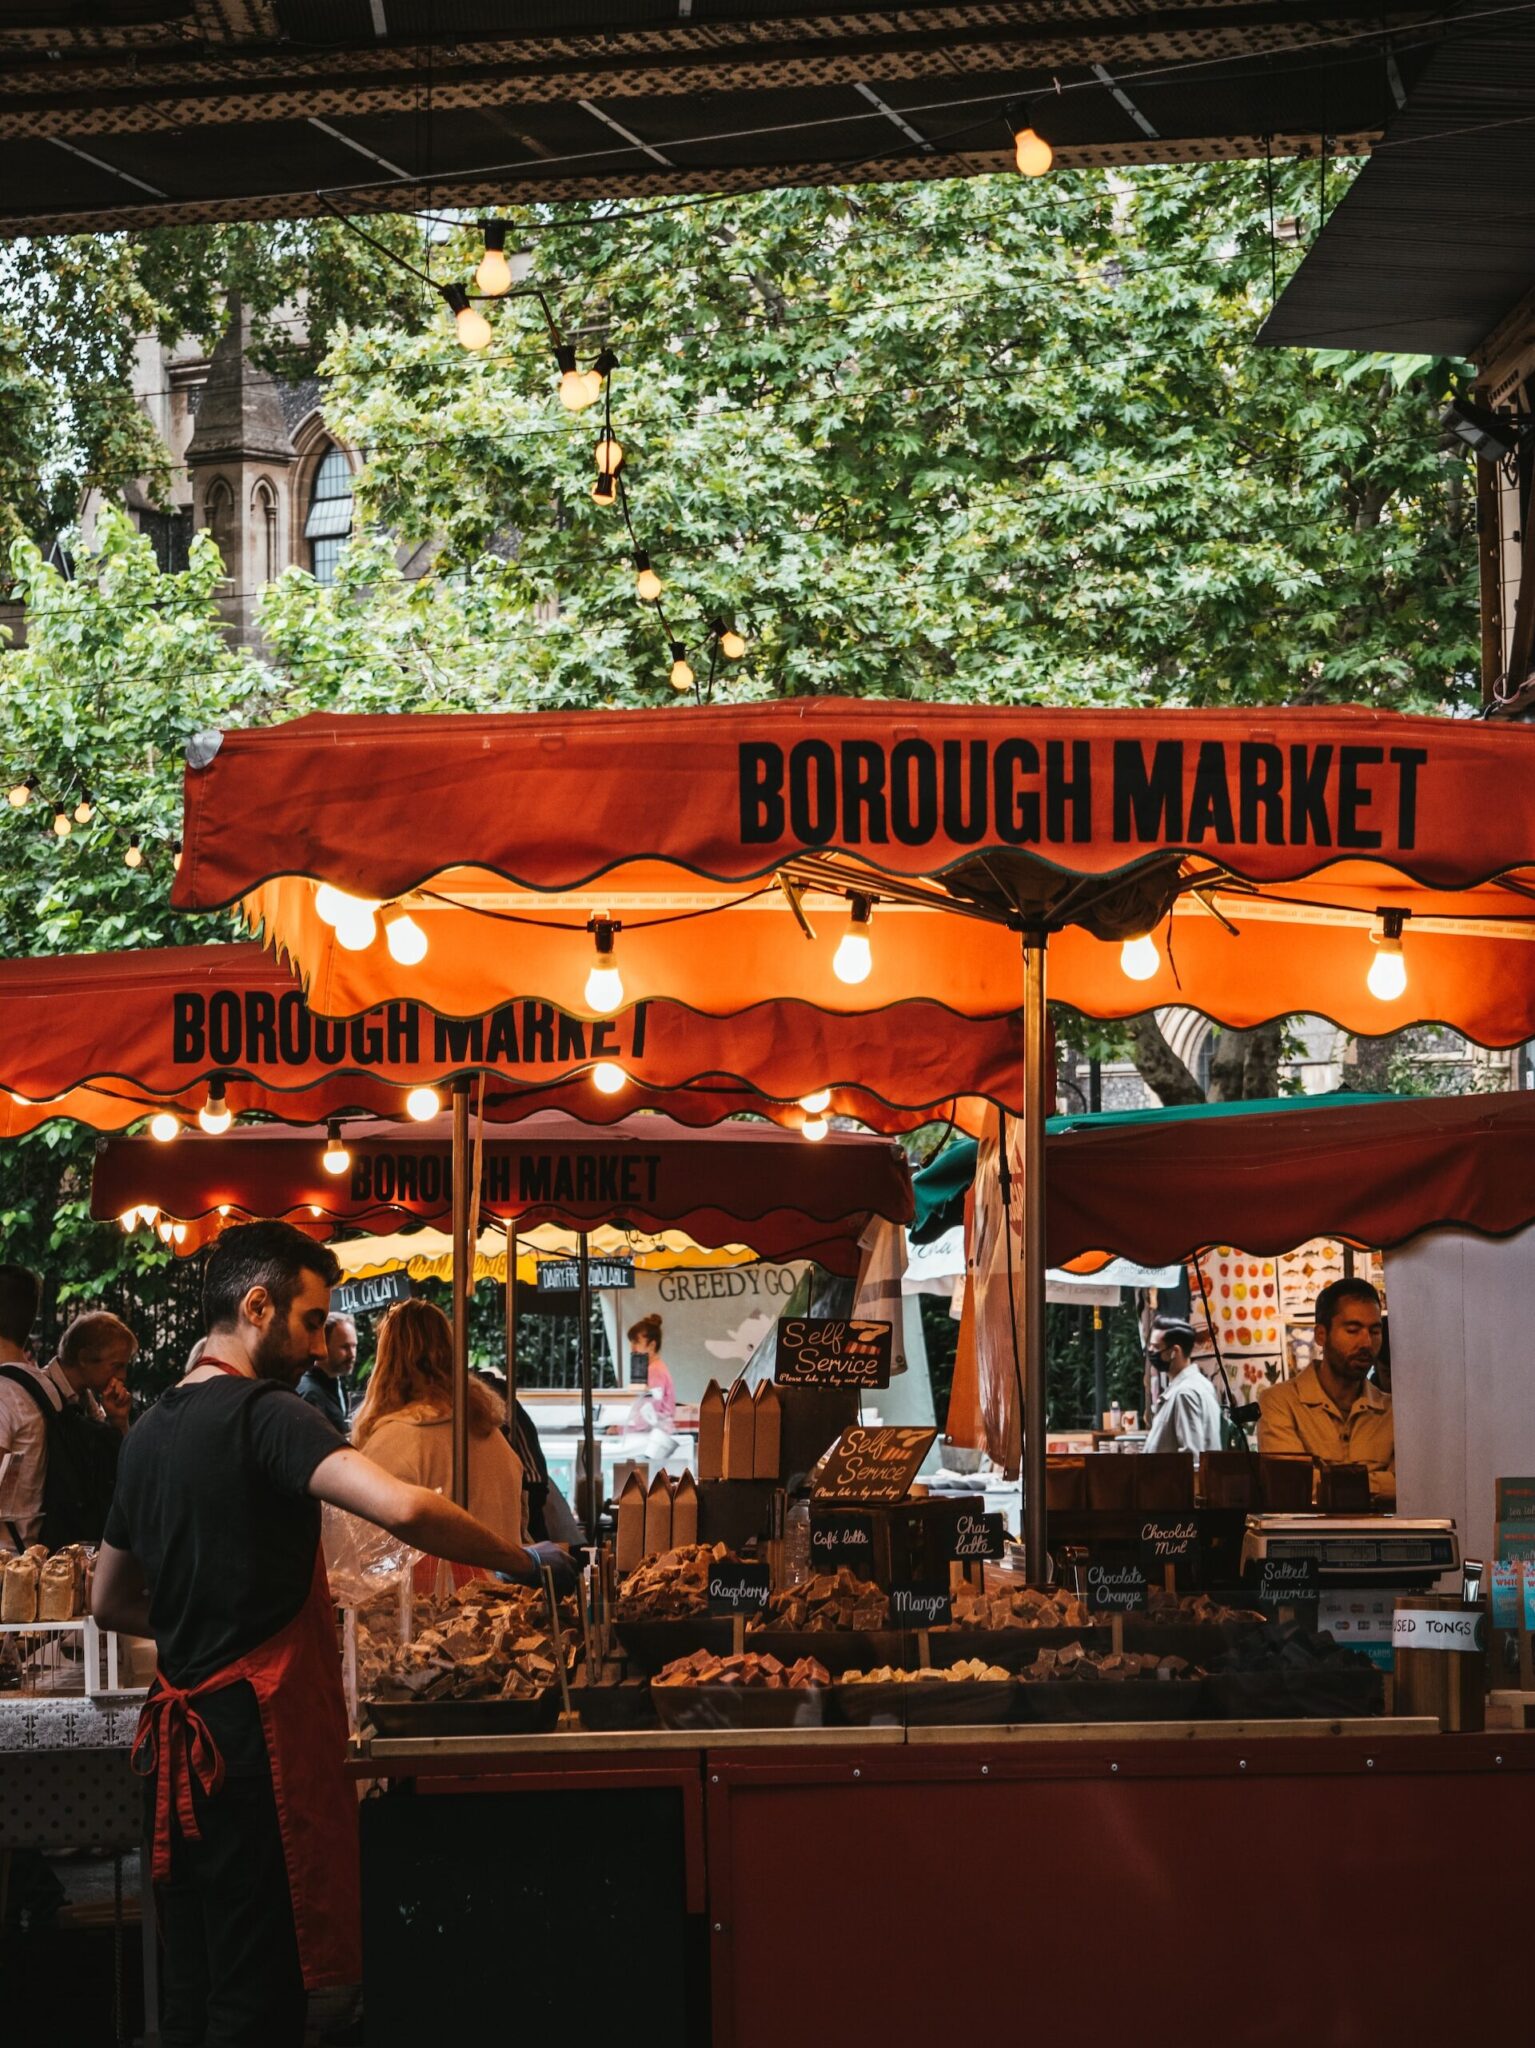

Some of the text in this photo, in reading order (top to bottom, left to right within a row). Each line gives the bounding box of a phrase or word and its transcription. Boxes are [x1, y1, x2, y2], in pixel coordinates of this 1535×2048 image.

[739, 739, 1428, 850] BOROUGH MARKET
[173, 990, 420, 1065] BOROUGH
[520, 1155, 661, 1202] MARKET
[543, 1266, 580, 1288] DAIRY-FRE
[658, 1268, 797, 1302] GREEDY GO
[340, 1283, 359, 1311] ICE
[361, 1275, 398, 1305] CREAM
[783, 1322, 845, 1354] Self
[795, 1349, 879, 1374] Service
[839, 1428, 892, 1460] Self
[837, 1457, 907, 1485] Service
[957, 1516, 990, 1534] Chai
[1141, 1523, 1197, 1541] Chocolate
[813, 1528, 869, 1550] Café latte
[955, 1535, 994, 1555] latte
[1155, 1540, 1188, 1556] Mint
[1088, 1566, 1146, 1584] Chocolate
[1264, 1562, 1309, 1581] Salted
[710, 1579, 769, 1605] Raspberry
[1096, 1585, 1142, 1610] Orange
[893, 1591, 947, 1621] Mango
[1426, 1620, 1471, 1635] TONGS
